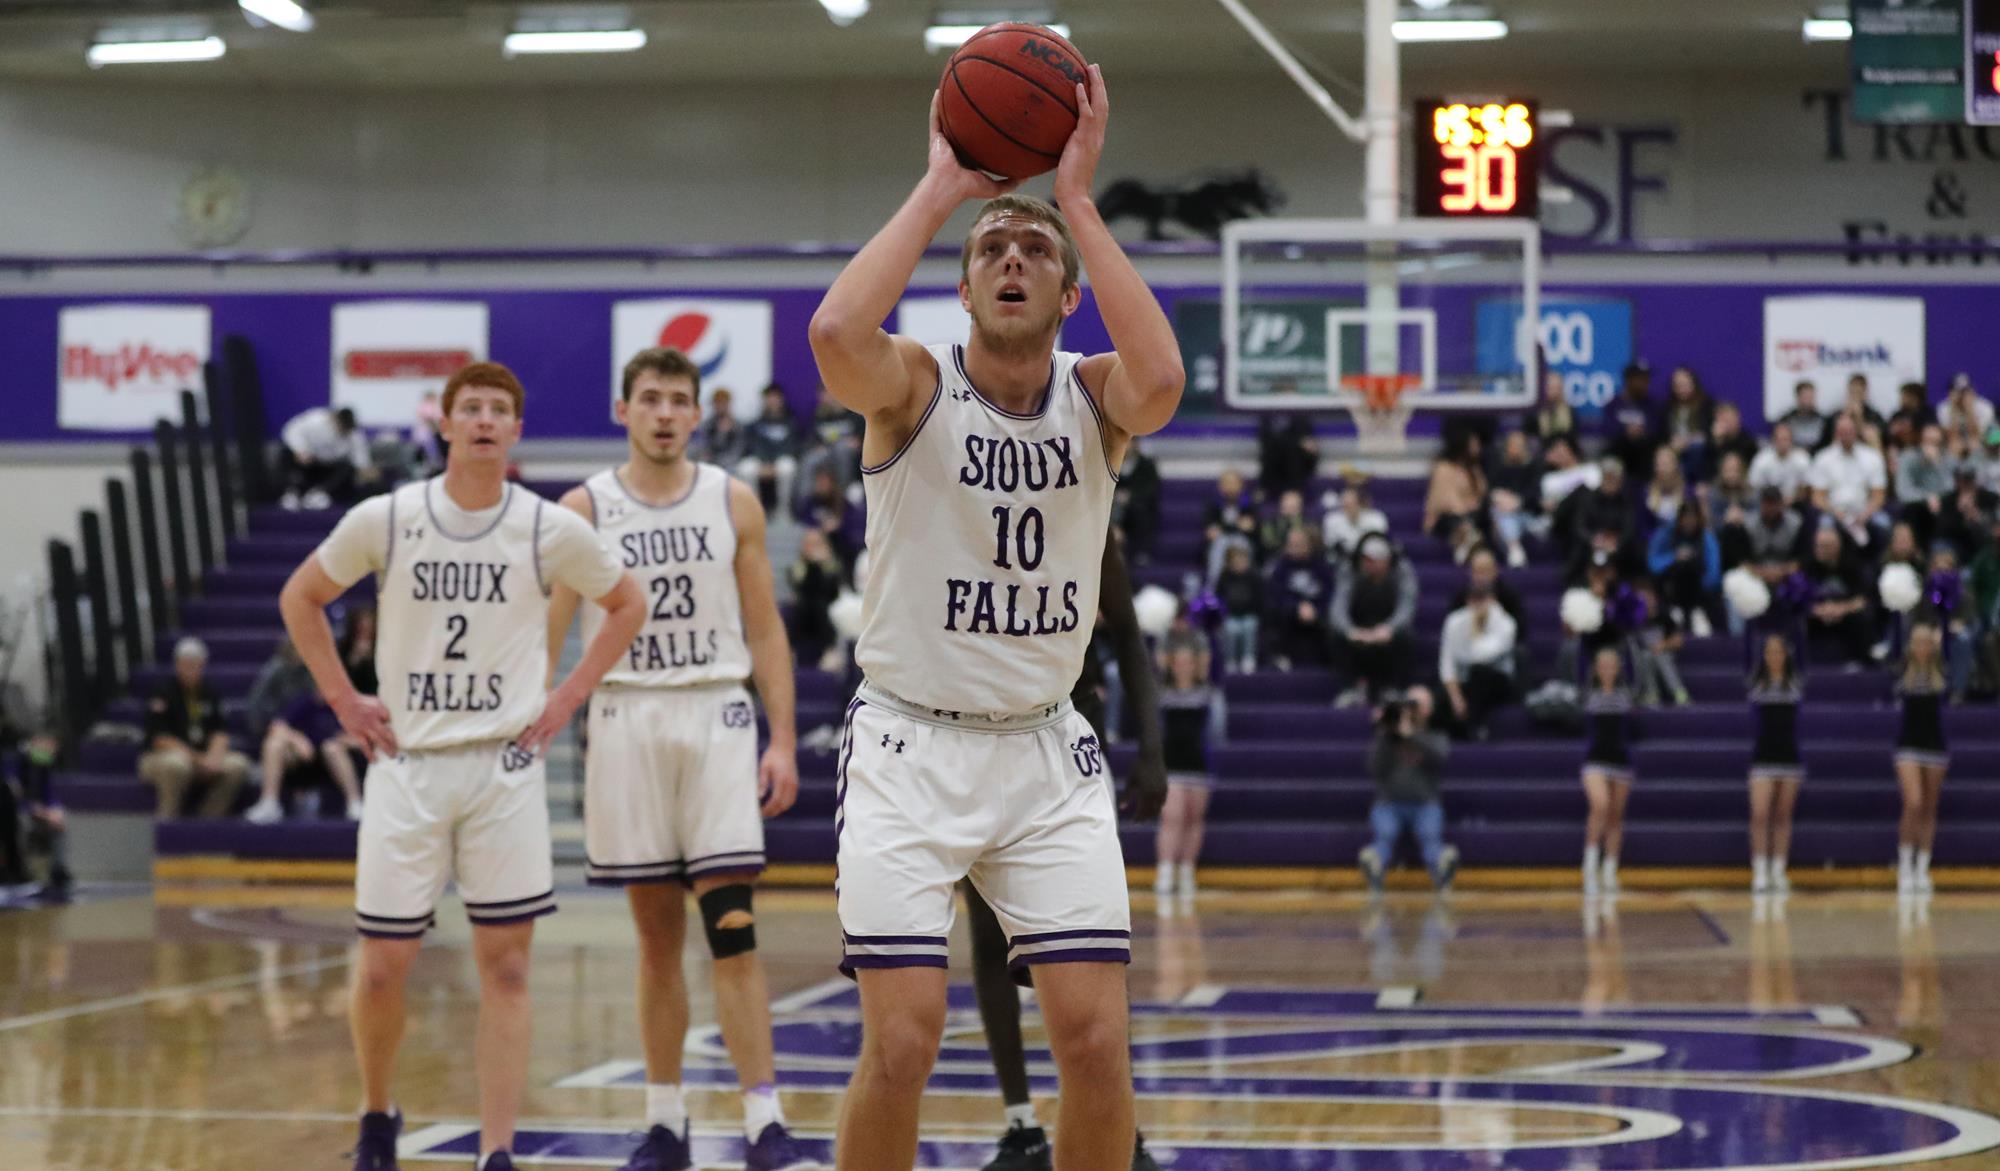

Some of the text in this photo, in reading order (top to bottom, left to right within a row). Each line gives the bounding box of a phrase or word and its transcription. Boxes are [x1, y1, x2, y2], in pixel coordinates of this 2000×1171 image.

[1434, 104, 1533, 148] 15:56
[1440, 144, 1517, 211] 30
[1538, 124, 1678, 241] SF
[959, 434, 1078, 493] SIOUX
[621, 525, 714, 569] SIOUX
[991, 505, 1045, 572] 10
[412, 561, 509, 603] SIOUX
[650, 574, 696, 620] 23
[944, 578, 1079, 637] FALLS
[443, 614, 469, 661] 2
[629, 628, 718, 672] FALLS
[406, 673, 504, 712] FALLS
[1073, 749, 1102, 777] US
